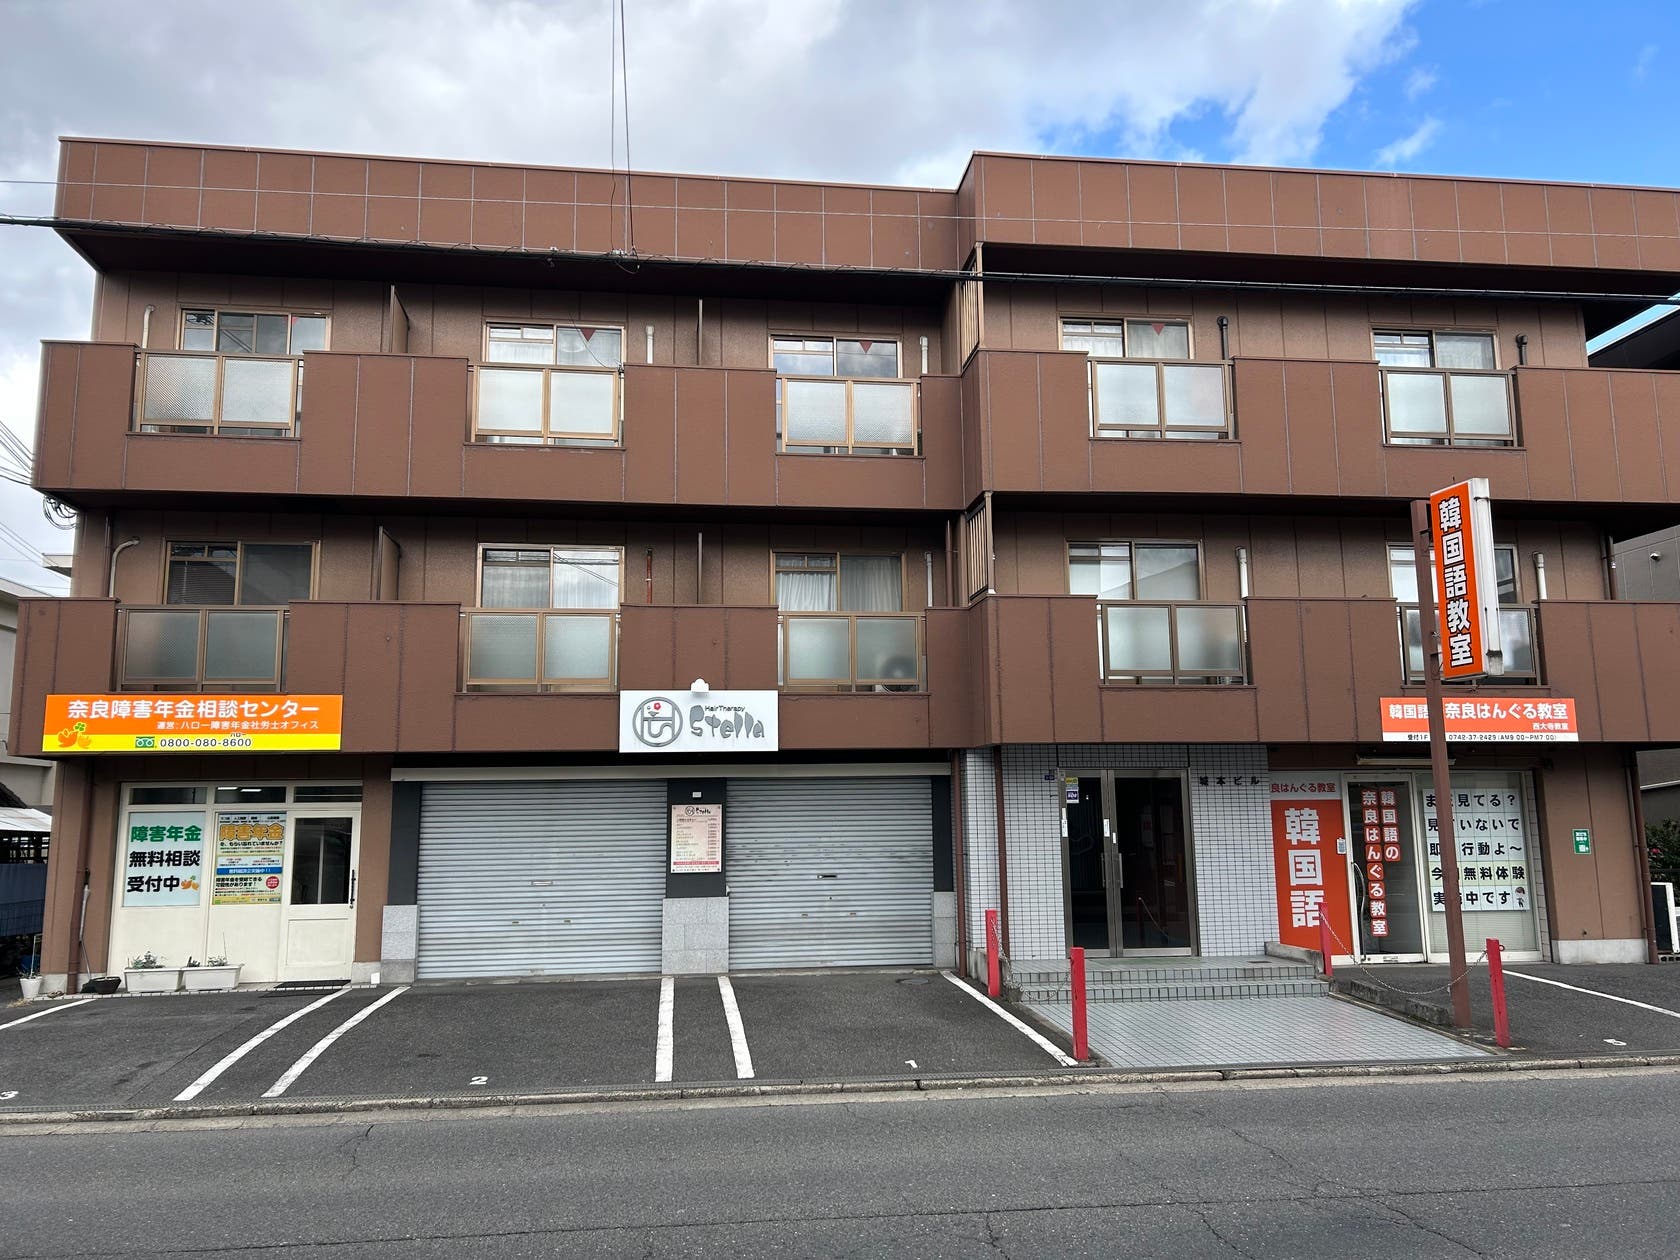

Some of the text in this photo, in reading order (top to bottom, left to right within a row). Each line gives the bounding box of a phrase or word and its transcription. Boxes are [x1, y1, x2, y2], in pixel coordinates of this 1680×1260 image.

[1438, 495, 1474, 668] 韓国語教室
[68, 700, 320, 719] 奈良障害年金相談センター
[1389, 703, 1568, 719] 韓国語奈良はんぐる教室
[690, 705, 765, 738] Stella
[160, 738, 252, 747] 0800-080-8600
[1381, 791, 1399, 860] 韓国語の
[1428, 818, 1520, 832] 見いないで
[130, 825, 201, 843] 障害年金
[129, 850, 200, 867] 無料相談
[1429, 843, 1522, 857] 即行動よ〜
[1285, 807, 1325, 927] 韓国語
[1362, 791, 1387, 935] 奈良はんぐる教室
[1431, 866, 1525, 880] 今無料体験
[127, 875, 180, 893] 受付中
[1433, 891, 1511, 905] 実中です
[470, 1076, 488, 1085] 2
